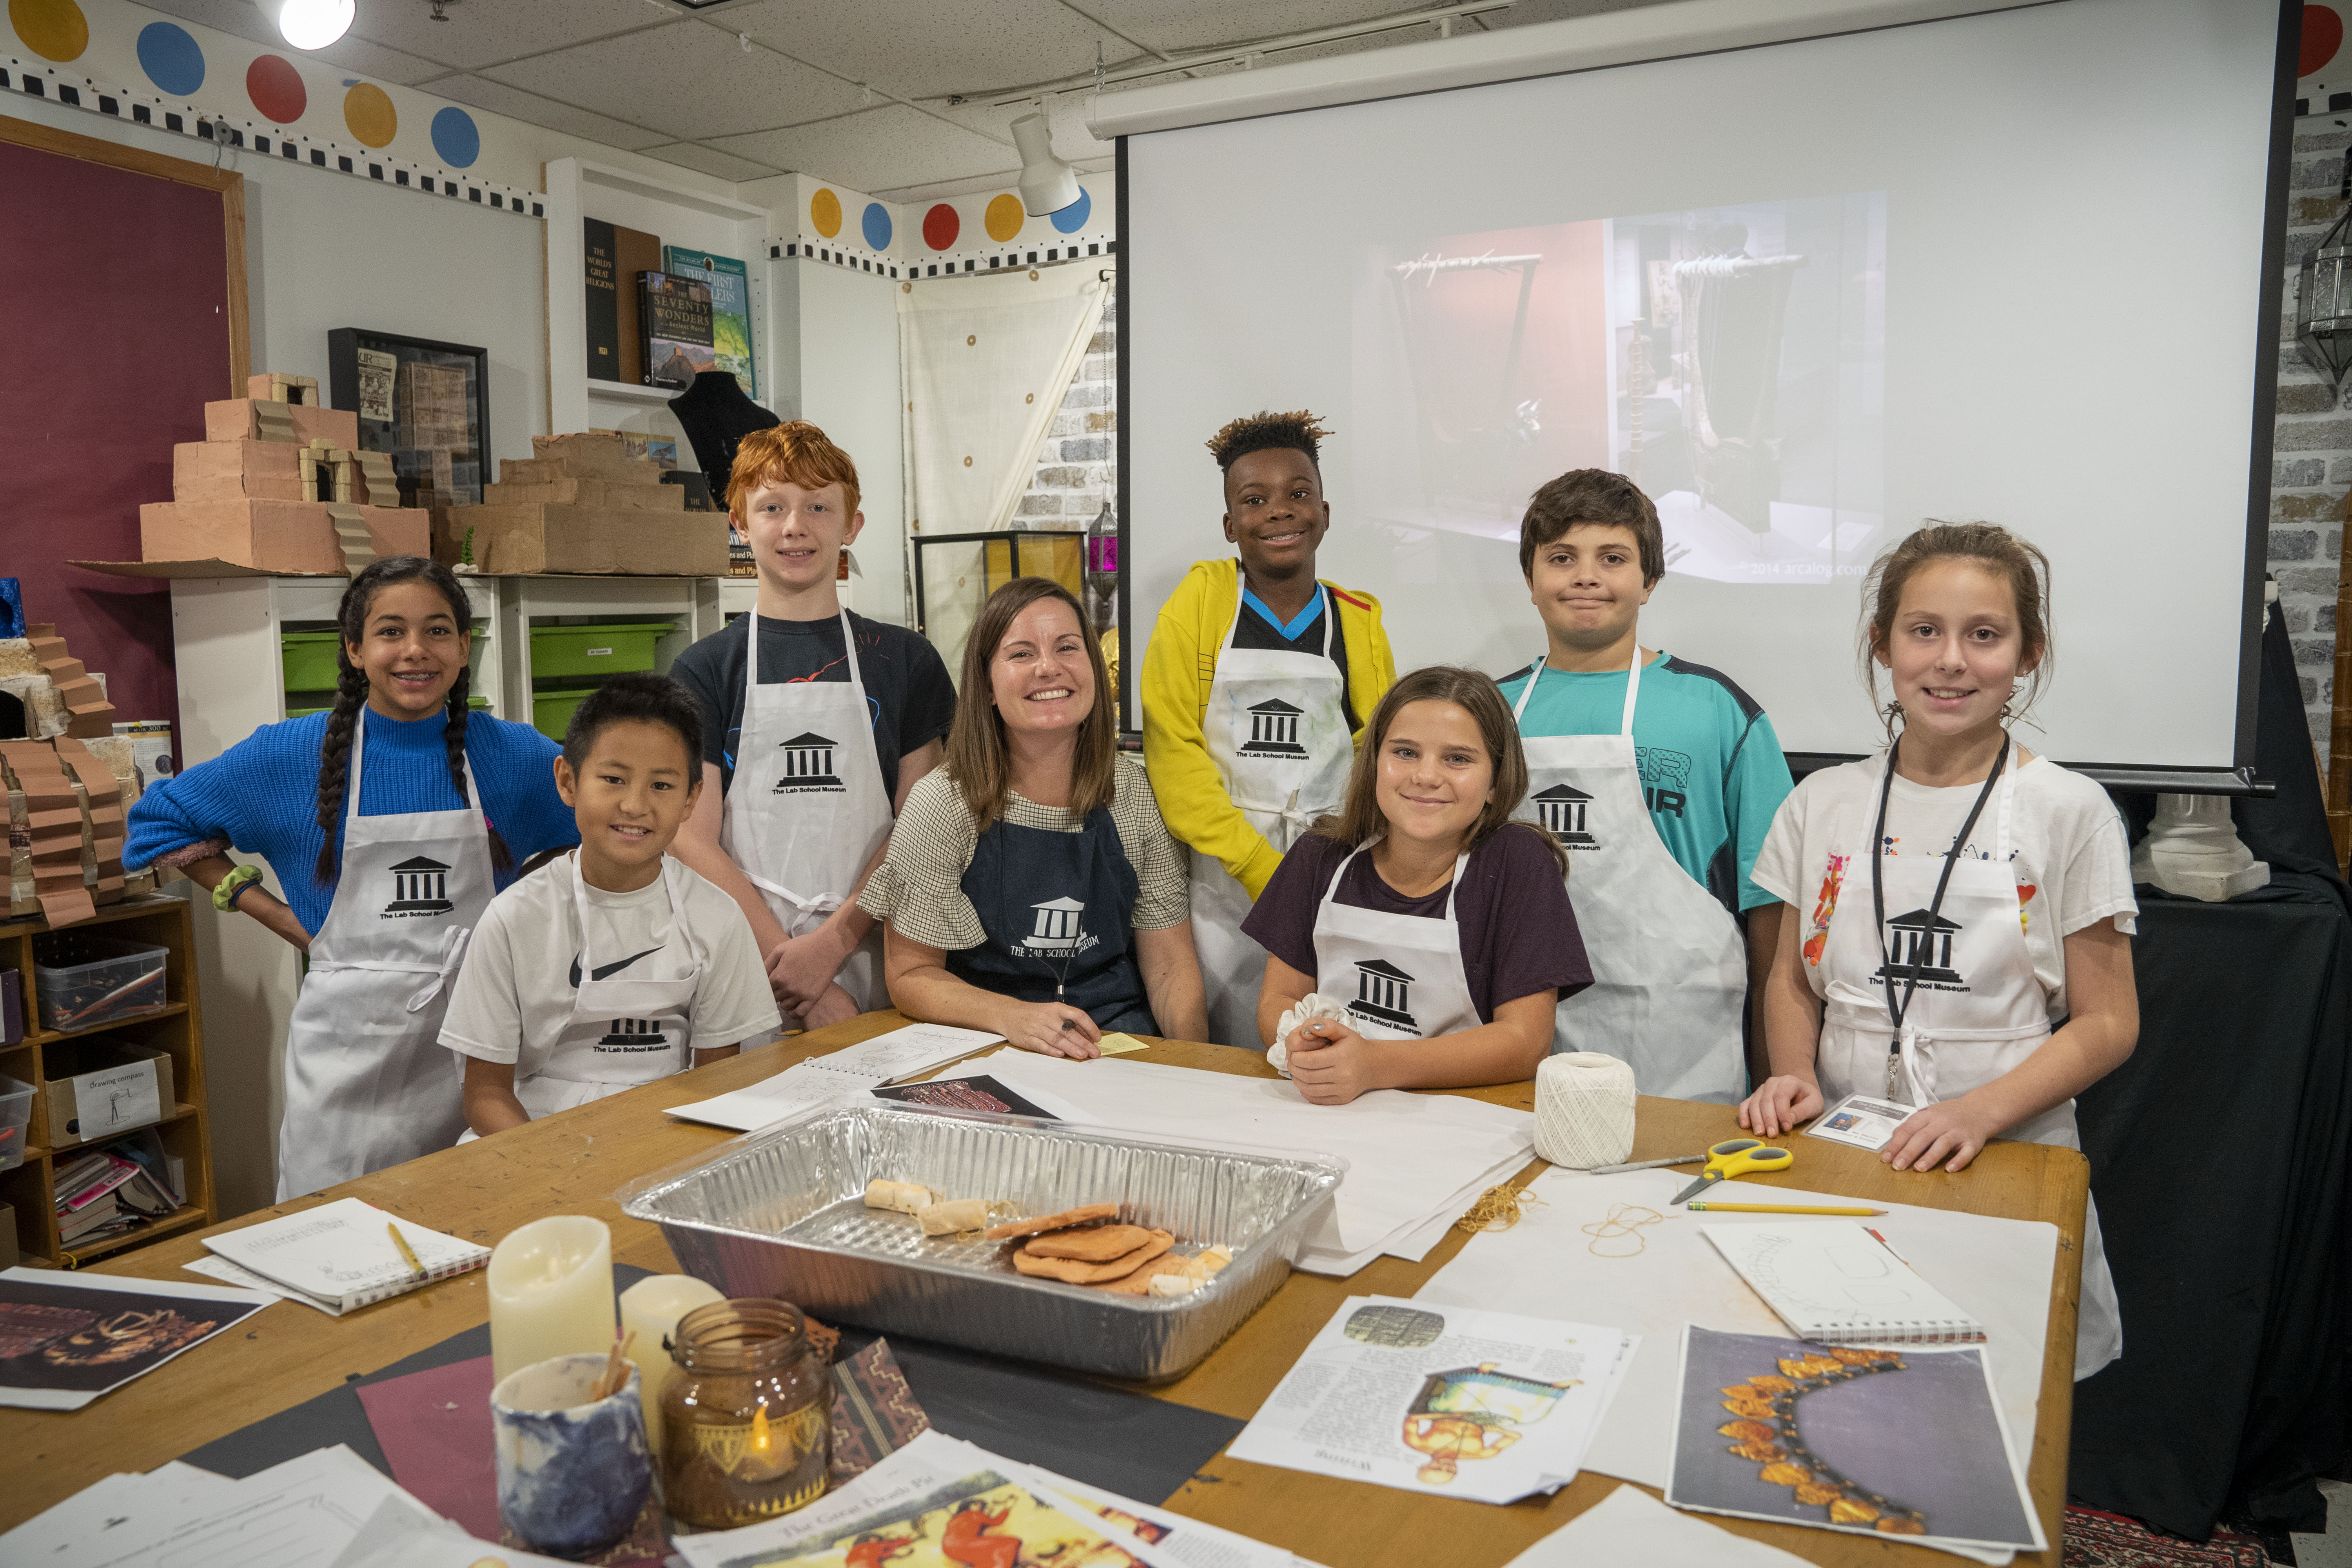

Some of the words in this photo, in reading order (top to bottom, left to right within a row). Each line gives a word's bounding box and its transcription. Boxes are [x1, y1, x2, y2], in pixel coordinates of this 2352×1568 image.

[593, 247, 604, 257] THE
[591, 267, 608, 278] GREAT
[586, 277, 614, 290] RELIGIONS
[708, 273, 734, 289] FIRST
[711, 287, 735, 303] LERS
[654, 295, 709, 314] SEVENTY
[655, 307, 709, 326] WONDERS
[747, 566, 756, 575] Pla
[1751, 563, 1779, 574] 2014
[1784, 561, 1867, 578] arcalog.com
[1010, 946, 1025, 957] THE
[1904, 980, 1932, 990] Shool
[1934, 983, 1970, 993] Museum
[1356, 1012, 1368, 1021] Lab
[1369, 1016, 1392, 1028] School
[1393, 1023, 1422, 1037] Museum
[118, 1072, 144, 1082] compass
